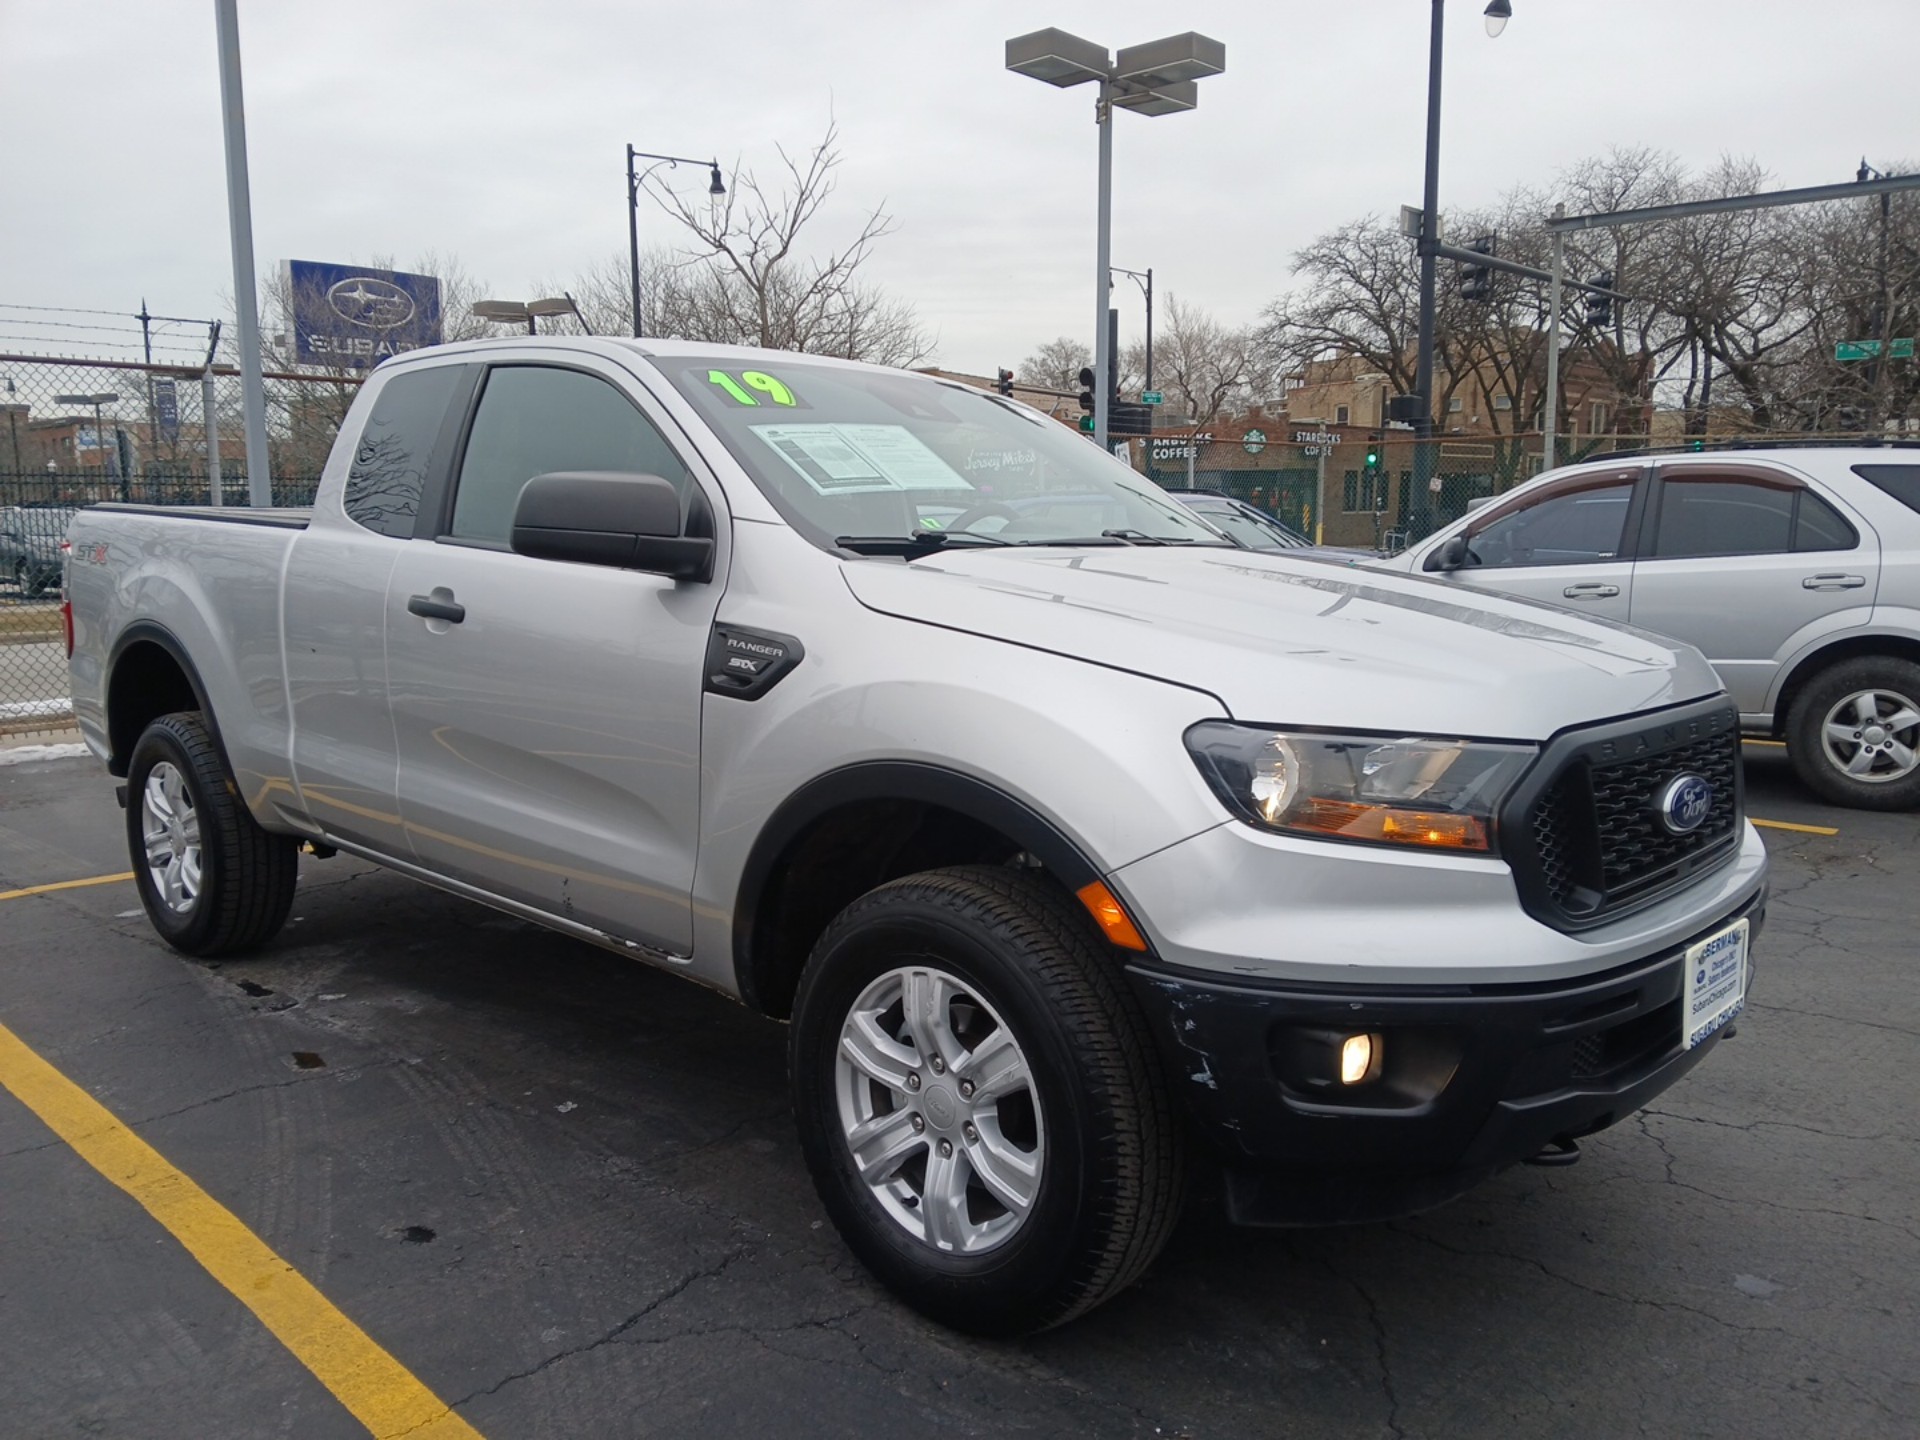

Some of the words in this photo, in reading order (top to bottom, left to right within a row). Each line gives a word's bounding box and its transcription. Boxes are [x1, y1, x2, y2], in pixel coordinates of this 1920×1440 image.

[707, 369, 797, 406] 19
[75, 542, 109, 565] STX
[727, 639, 783, 657] RANGER
[728, 657, 758, 672] STX
[1682, 784, 1707, 820] Ford
